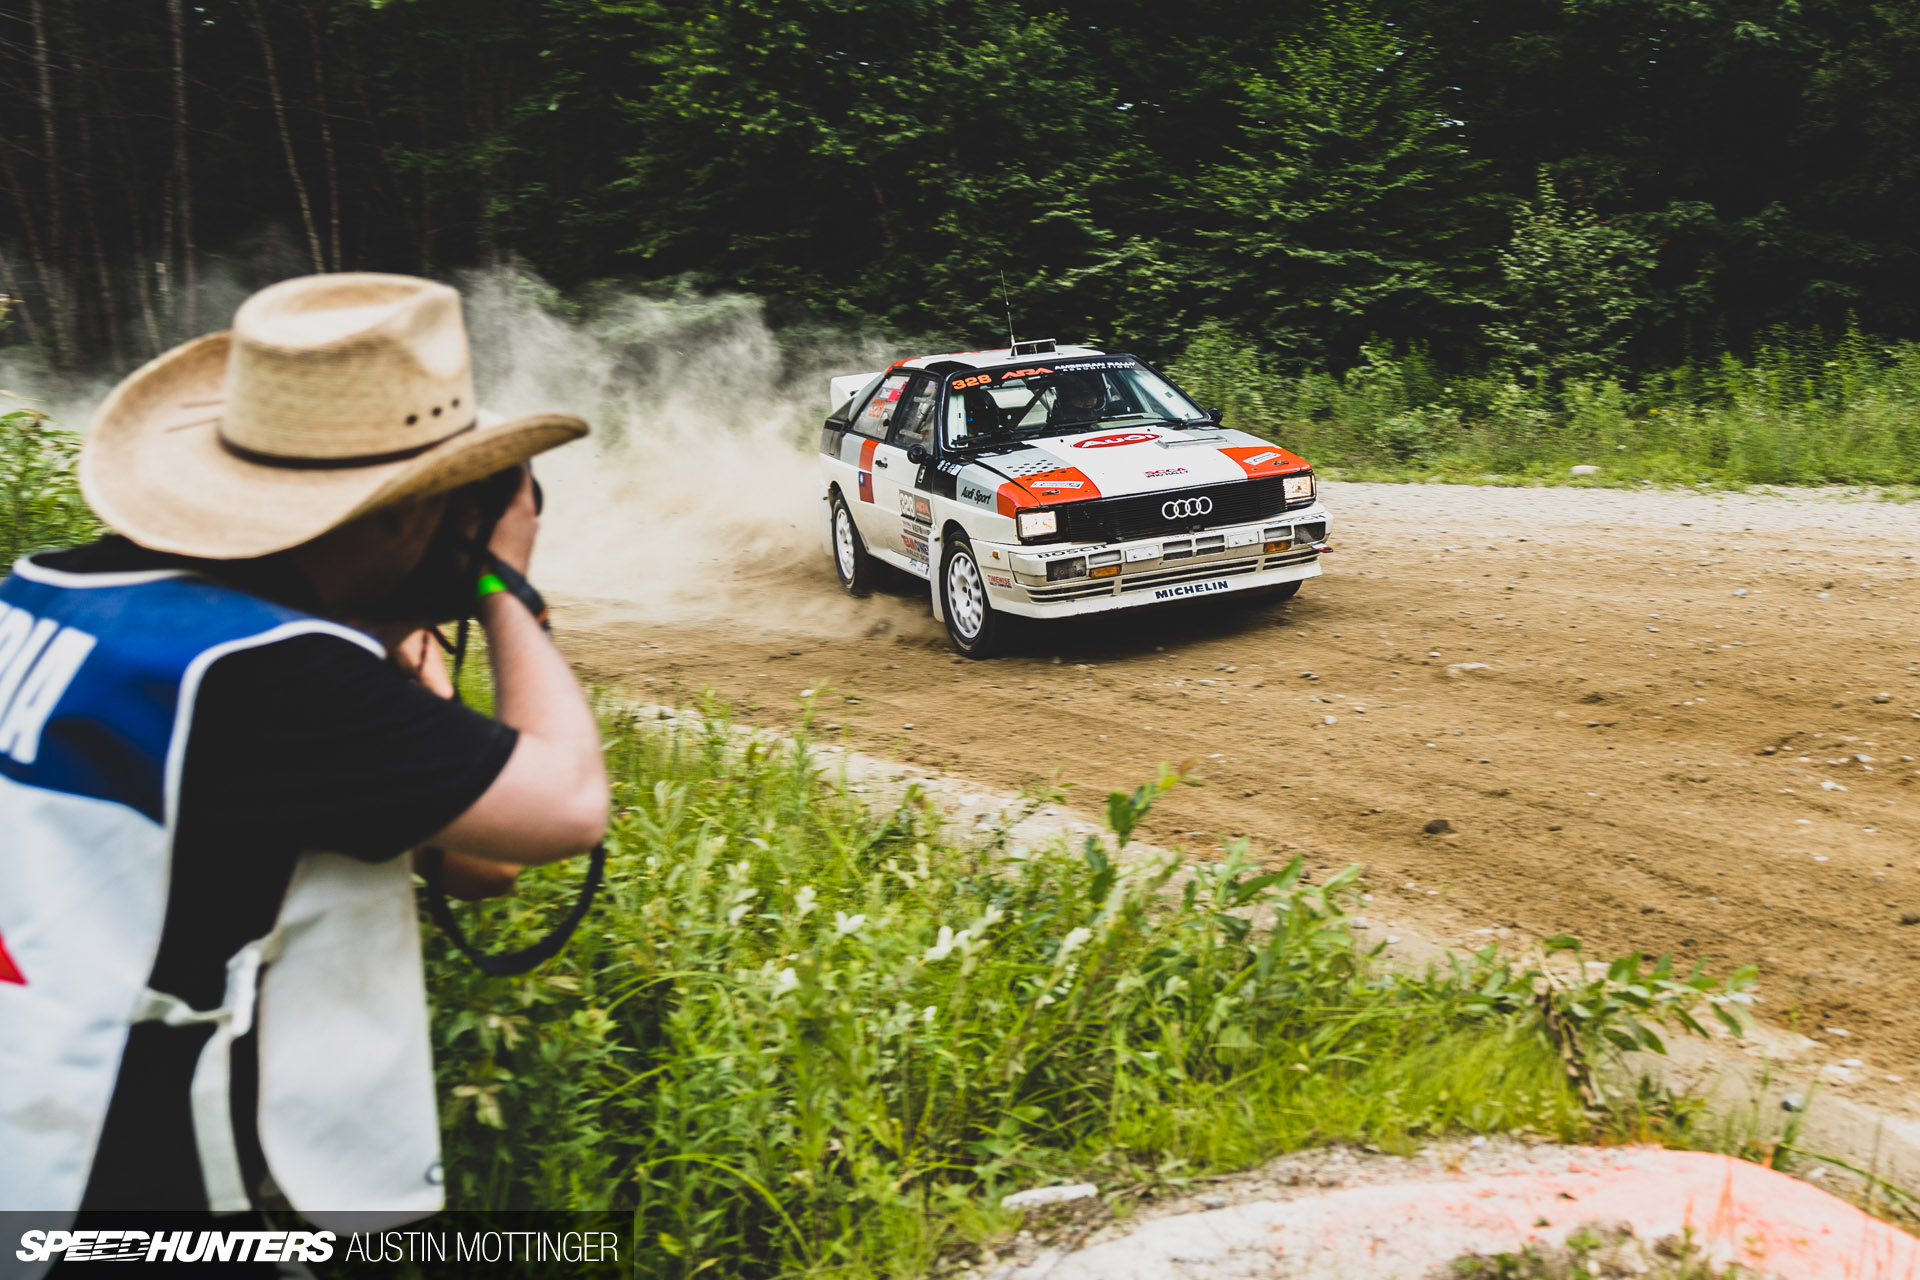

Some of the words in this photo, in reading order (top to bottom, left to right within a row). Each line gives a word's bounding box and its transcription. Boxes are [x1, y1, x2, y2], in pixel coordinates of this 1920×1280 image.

[1001, 367, 1054, 380] ARA
[1054, 362, 1106, 371] AMERICAN
[952, 374, 992, 390] 328
[960, 485, 975, 500] Audi
[974, 489, 992, 505] Sport
[1037, 544, 1107, 558] BOSCH
[1154, 580, 1228, 600] MICHELIN
[0, 600, 98, 765] DIA
